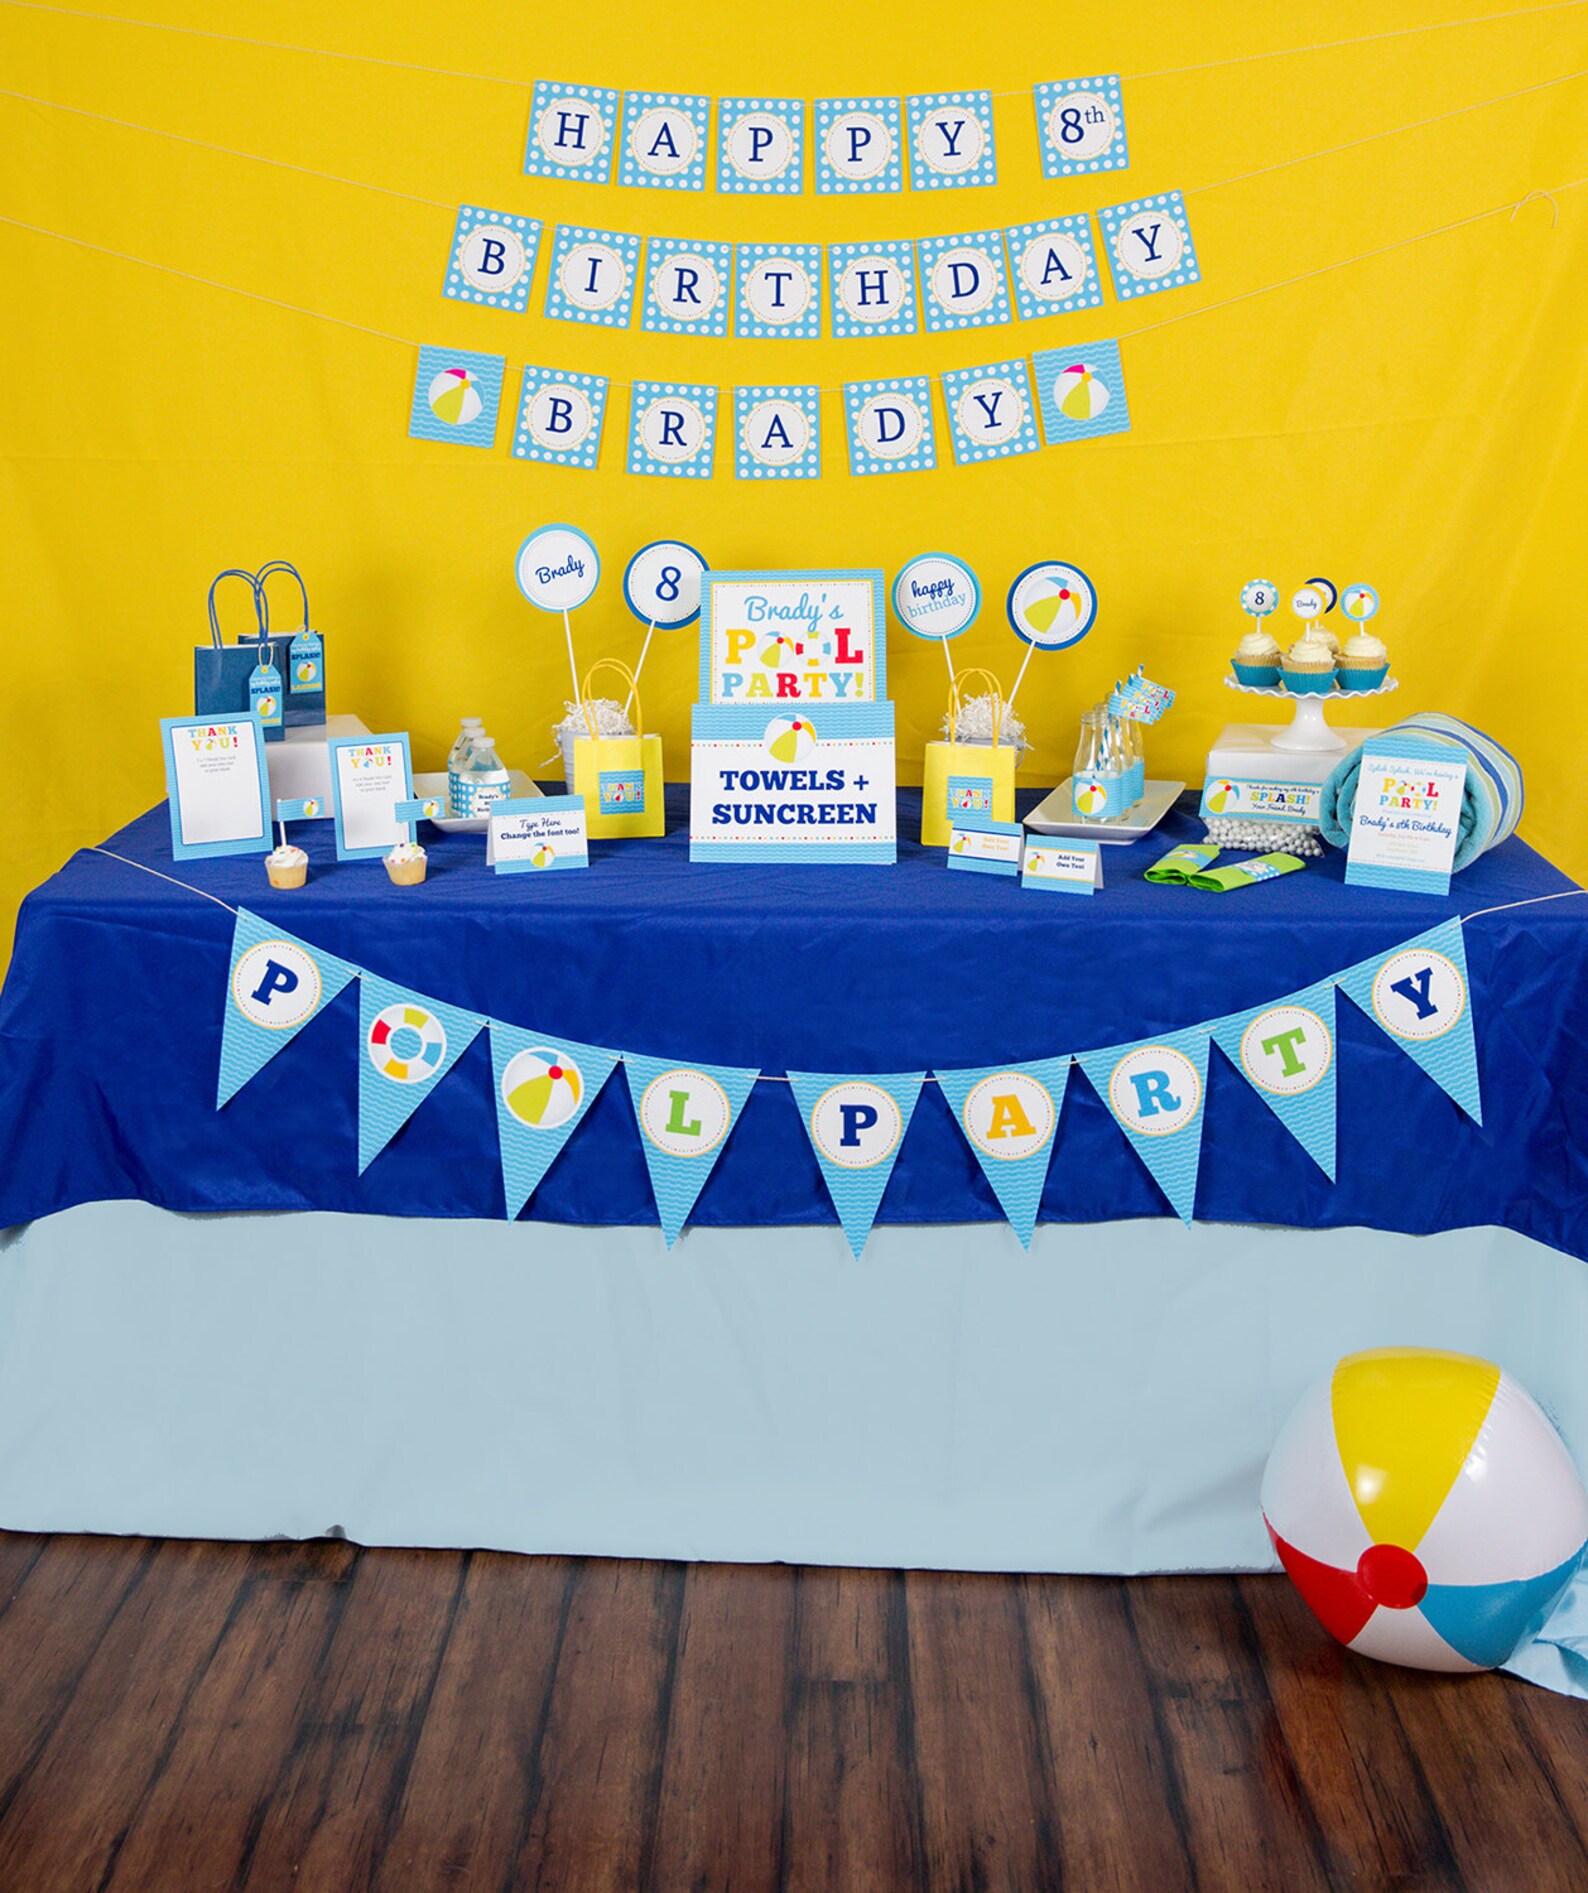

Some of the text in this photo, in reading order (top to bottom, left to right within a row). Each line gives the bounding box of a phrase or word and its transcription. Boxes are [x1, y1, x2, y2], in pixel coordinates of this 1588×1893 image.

[554, 105, 1106, 162] HAPPY 8th
[477, 223, 1162, 307] BIRTHDAY
[545, 391, 1003, 449] BRADY
[535, 555, 585, 584] Brady
[655, 566, 682, 602] 8
[911, 578, 955, 600] happy
[907, 592, 966, 618] birthday
[1254, 591, 1265, 605] 8
[1296, 598, 1317, 610] Brady
[744, 592, 844, 632] Brady's
[722, 672, 864, 699] PARTY!
[188, 726, 237, 738] THANK
[347, 746, 392, 757] THANK
[719, 769, 869, 791] TOWELS +
[951, 789, 990, 797] THANK
[1250, 791, 1311, 805] SPLASH!
[1379, 795, 1438, 811] PARTY!
[520, 817, 562, 832] Type Here
[712, 803, 878, 825] SUNCREEN
[500, 827, 580, 841] Change the font too!
[1359, 815, 1395, 832] Brady's
[1411, 820, 1452, 839] Birthday
[1058, 854, 1085, 863] Add Your
[1071, 862, 1085, 870] Text
